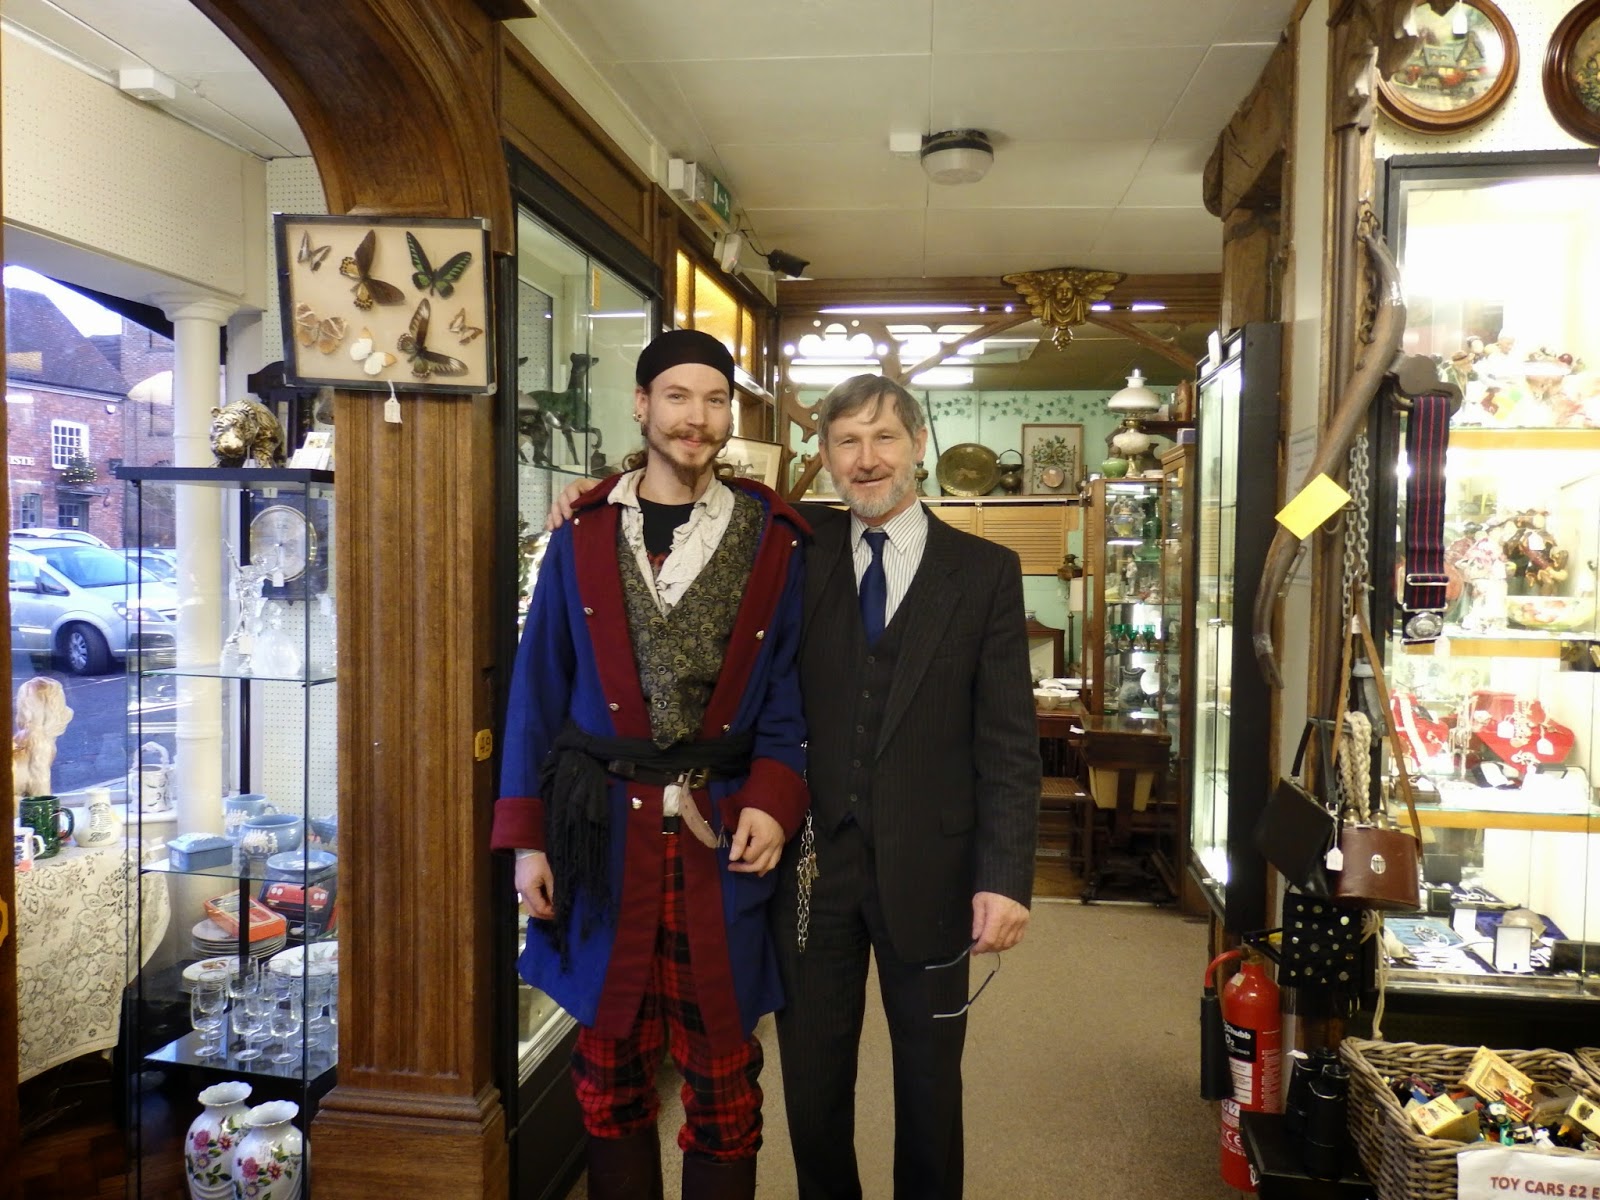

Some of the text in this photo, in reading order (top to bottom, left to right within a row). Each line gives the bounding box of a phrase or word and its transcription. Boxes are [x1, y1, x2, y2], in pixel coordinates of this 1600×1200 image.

[1226, 1024, 1252, 1040] Chubb
[1490, 1176, 1520, 1191] TOY
[1524, 1180, 1565, 1197] CARS
[1569, 1184, 1587, 1199] £2
